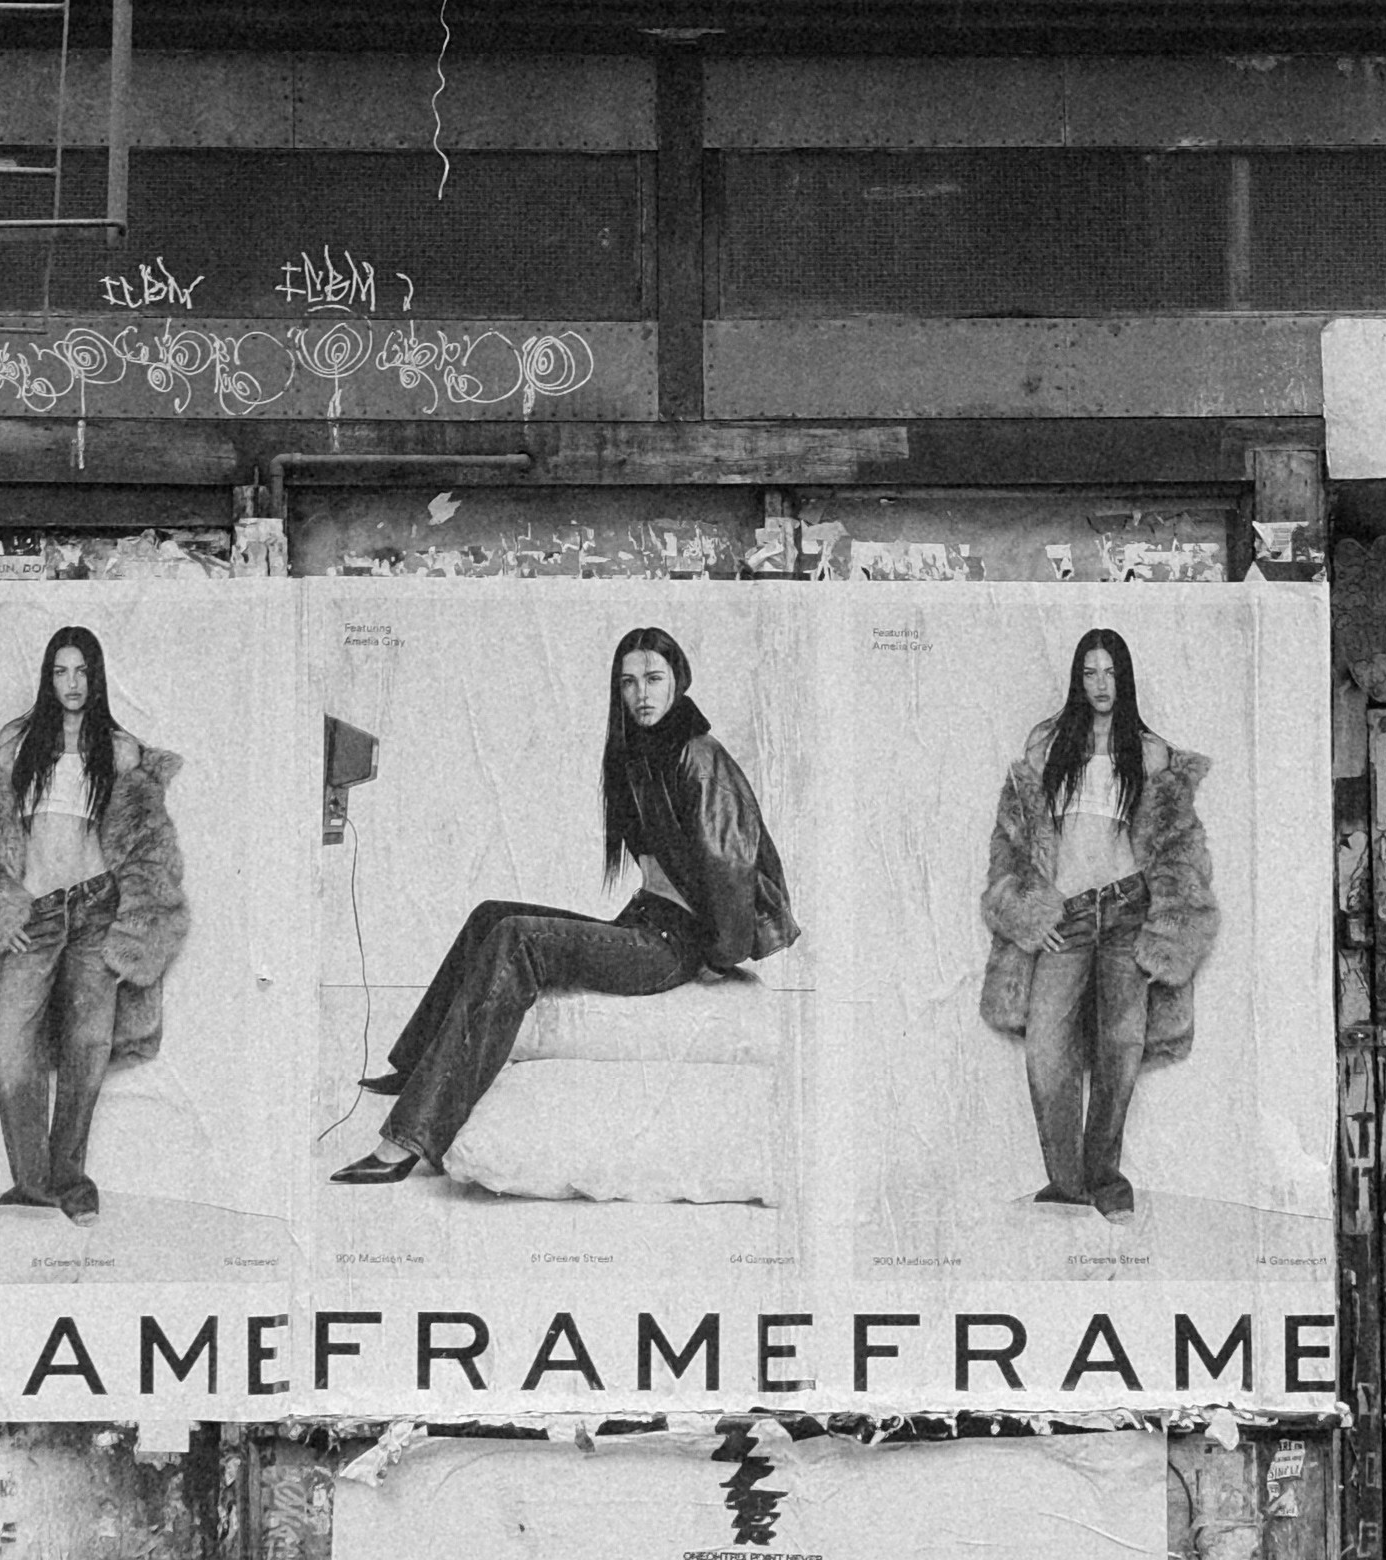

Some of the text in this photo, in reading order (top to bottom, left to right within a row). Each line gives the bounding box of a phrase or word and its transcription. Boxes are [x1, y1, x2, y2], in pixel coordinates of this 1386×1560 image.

[344, 622, 392, 635] Featuring
[872, 627, 919, 640] Featuring
[343, 636, 406, 648] Amelia Gray
[871, 640, 934, 652] Amelia Gray
[335, 1253, 356, 1264] 900
[872, 1256, 894, 1266] 900
[942, 1256, 962, 1266] Ave
[1119, 1254, 1150, 1265] Street
[314, 1311, 815, 1392] FRAME
[854, 1313, 1336, 1393] FRAME
